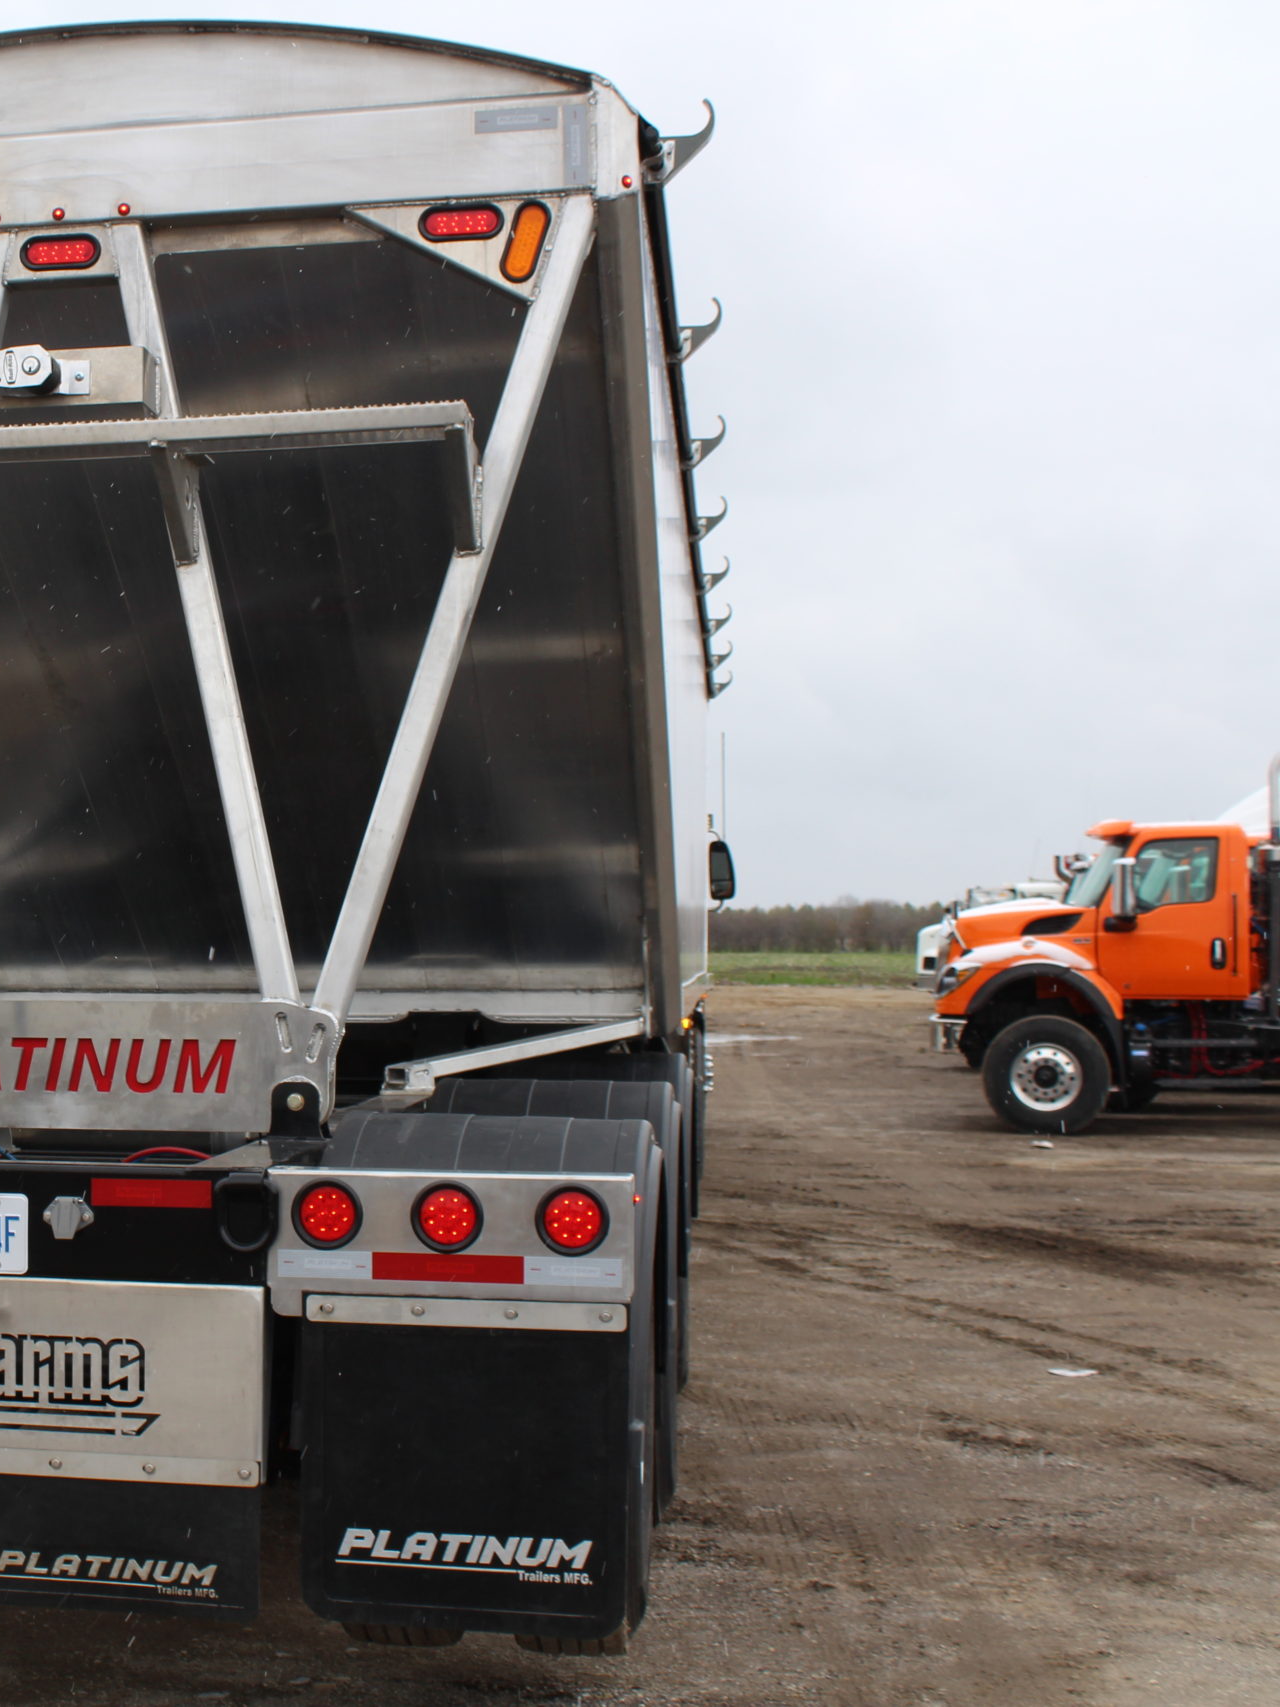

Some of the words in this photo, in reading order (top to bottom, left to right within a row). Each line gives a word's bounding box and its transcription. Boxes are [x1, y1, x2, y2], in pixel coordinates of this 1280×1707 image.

[338, 1528, 593, 1570] PLATINUM
[517, 1570, 561, 1584] Trailers
[564, 1572, 593, 1585] MFG.
[157, 1584, 193, 1597] Trailers
[195, 1587, 219, 1599] MFG.
